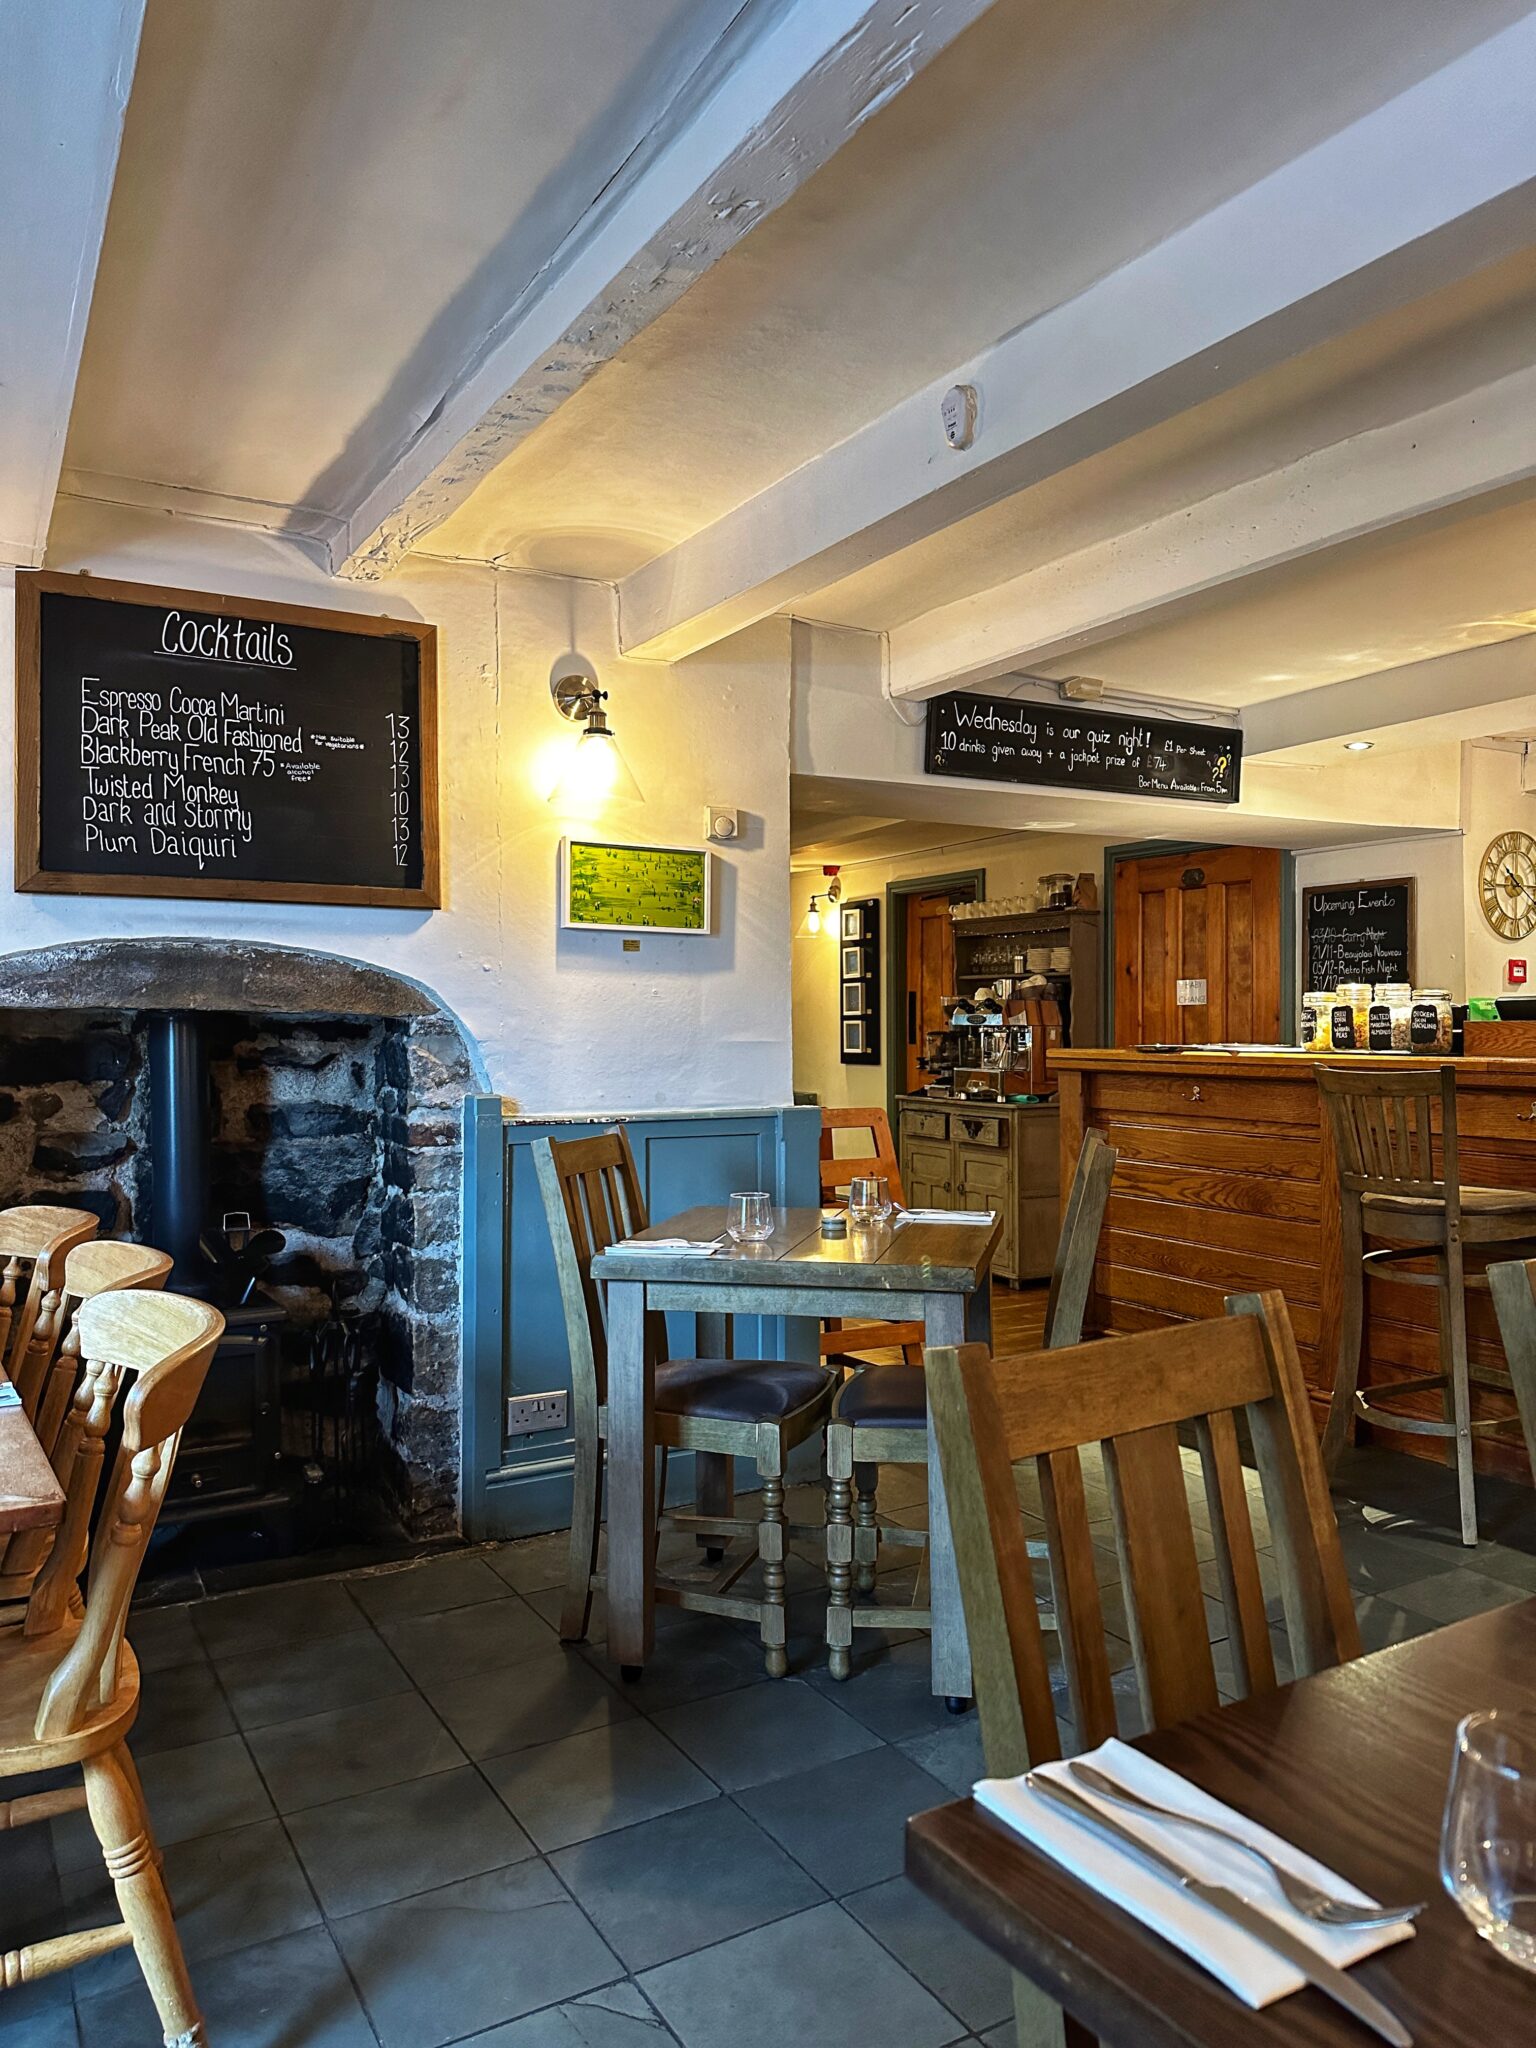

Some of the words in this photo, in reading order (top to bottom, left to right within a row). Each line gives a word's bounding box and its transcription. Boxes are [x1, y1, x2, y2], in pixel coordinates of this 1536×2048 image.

[161, 611, 293, 666] Cocktails
[81, 677, 161, 716] Espresso
[169, 686, 216, 717] Cocoa
[221, 691, 285, 726] Martini
[385, 713, 410, 739] 13
[953, 701, 1037, 744] Wednesday
[1046, 722, 1054, 736] is
[1063, 728, 1081, 739] our
[1087, 730, 1110, 753] quiz
[1118, 726, 1151, 756] night!
[81, 706, 130, 738] Dark
[140, 710, 182, 742] Peak
[187, 714, 219, 744] Old
[224, 719, 303, 754] Fashioned
[390, 740, 409, 763] 12
[940, 731, 957, 750] 10
[958, 738, 986, 753] drinks
[991, 742, 1015, 762] given
[1020, 748, 1042, 764] away
[1060, 752, 1066, 760] a
[1067, 749, 1100, 772] jackpot
[1105, 755, 1126, 770] prize
[1132, 757, 1141, 768] of
[1164, 740, 1173, 752] £1
[81, 734, 179, 777] Blackberry
[184, 743, 246, 776] French
[250, 748, 275, 777] 75
[390, 764, 410, 789] 13
[1138, 774, 1151, 788] Bar
[1151, 778, 1169, 790] Menu
[1200, 782, 1216, 792] From
[80, 765, 153, 799] Twisted
[163, 773, 240, 811] Monkey
[390, 791, 409, 815] 10
[83, 796, 133, 825] Dark
[143, 801, 176, 826] and
[184, 802, 252, 842] Stormy
[391, 817, 410, 841] 13
[86, 823, 138, 853] Plum
[150, 827, 237, 870] Daiquiri
[393, 844, 408, 866] 12
[1313, 894, 1355, 916] Upcoming
[1358, 890, 1396, 909] Events
[1361, 959, 1376, 974] Fish
[1377, 959, 1399, 975] Night
[1370, 1013, 1389, 1021] SALTED
